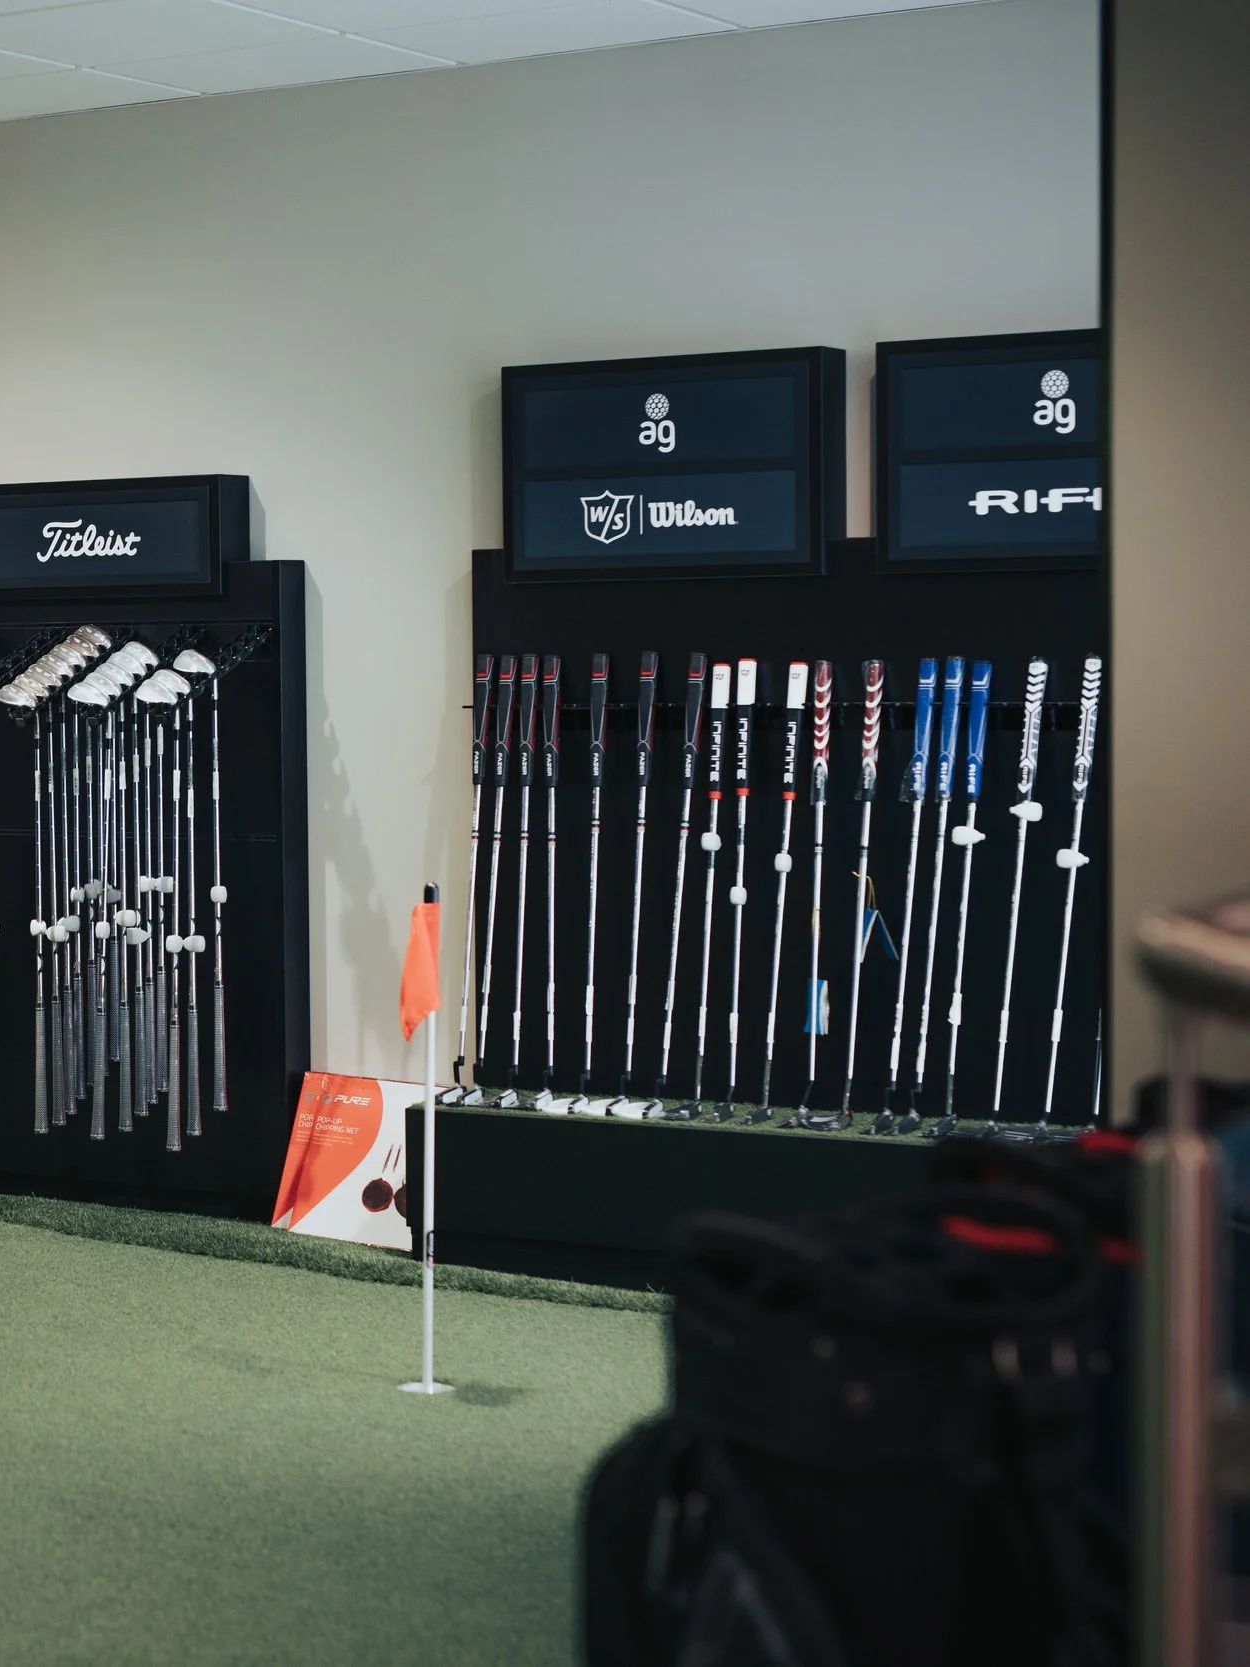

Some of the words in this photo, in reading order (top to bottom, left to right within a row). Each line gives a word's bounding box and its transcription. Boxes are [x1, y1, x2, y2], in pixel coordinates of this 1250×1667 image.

[1033, 398, 1076, 434] ag
[639, 420, 675, 453] ag
[648, 500, 737, 528] Wilson
[37, 519, 141, 562] Titleist
[710, 721, 722, 782] INFINITE
[736, 718, 748, 780] INFINITE
[784, 722, 797, 784] INFINITE
[684, 754, 692, 778] FAZER
[334, 1094, 371, 1106] PURE
[316, 1124, 344, 1133] CHIPPING
[317, 1116, 342, 1124] POP-UP
